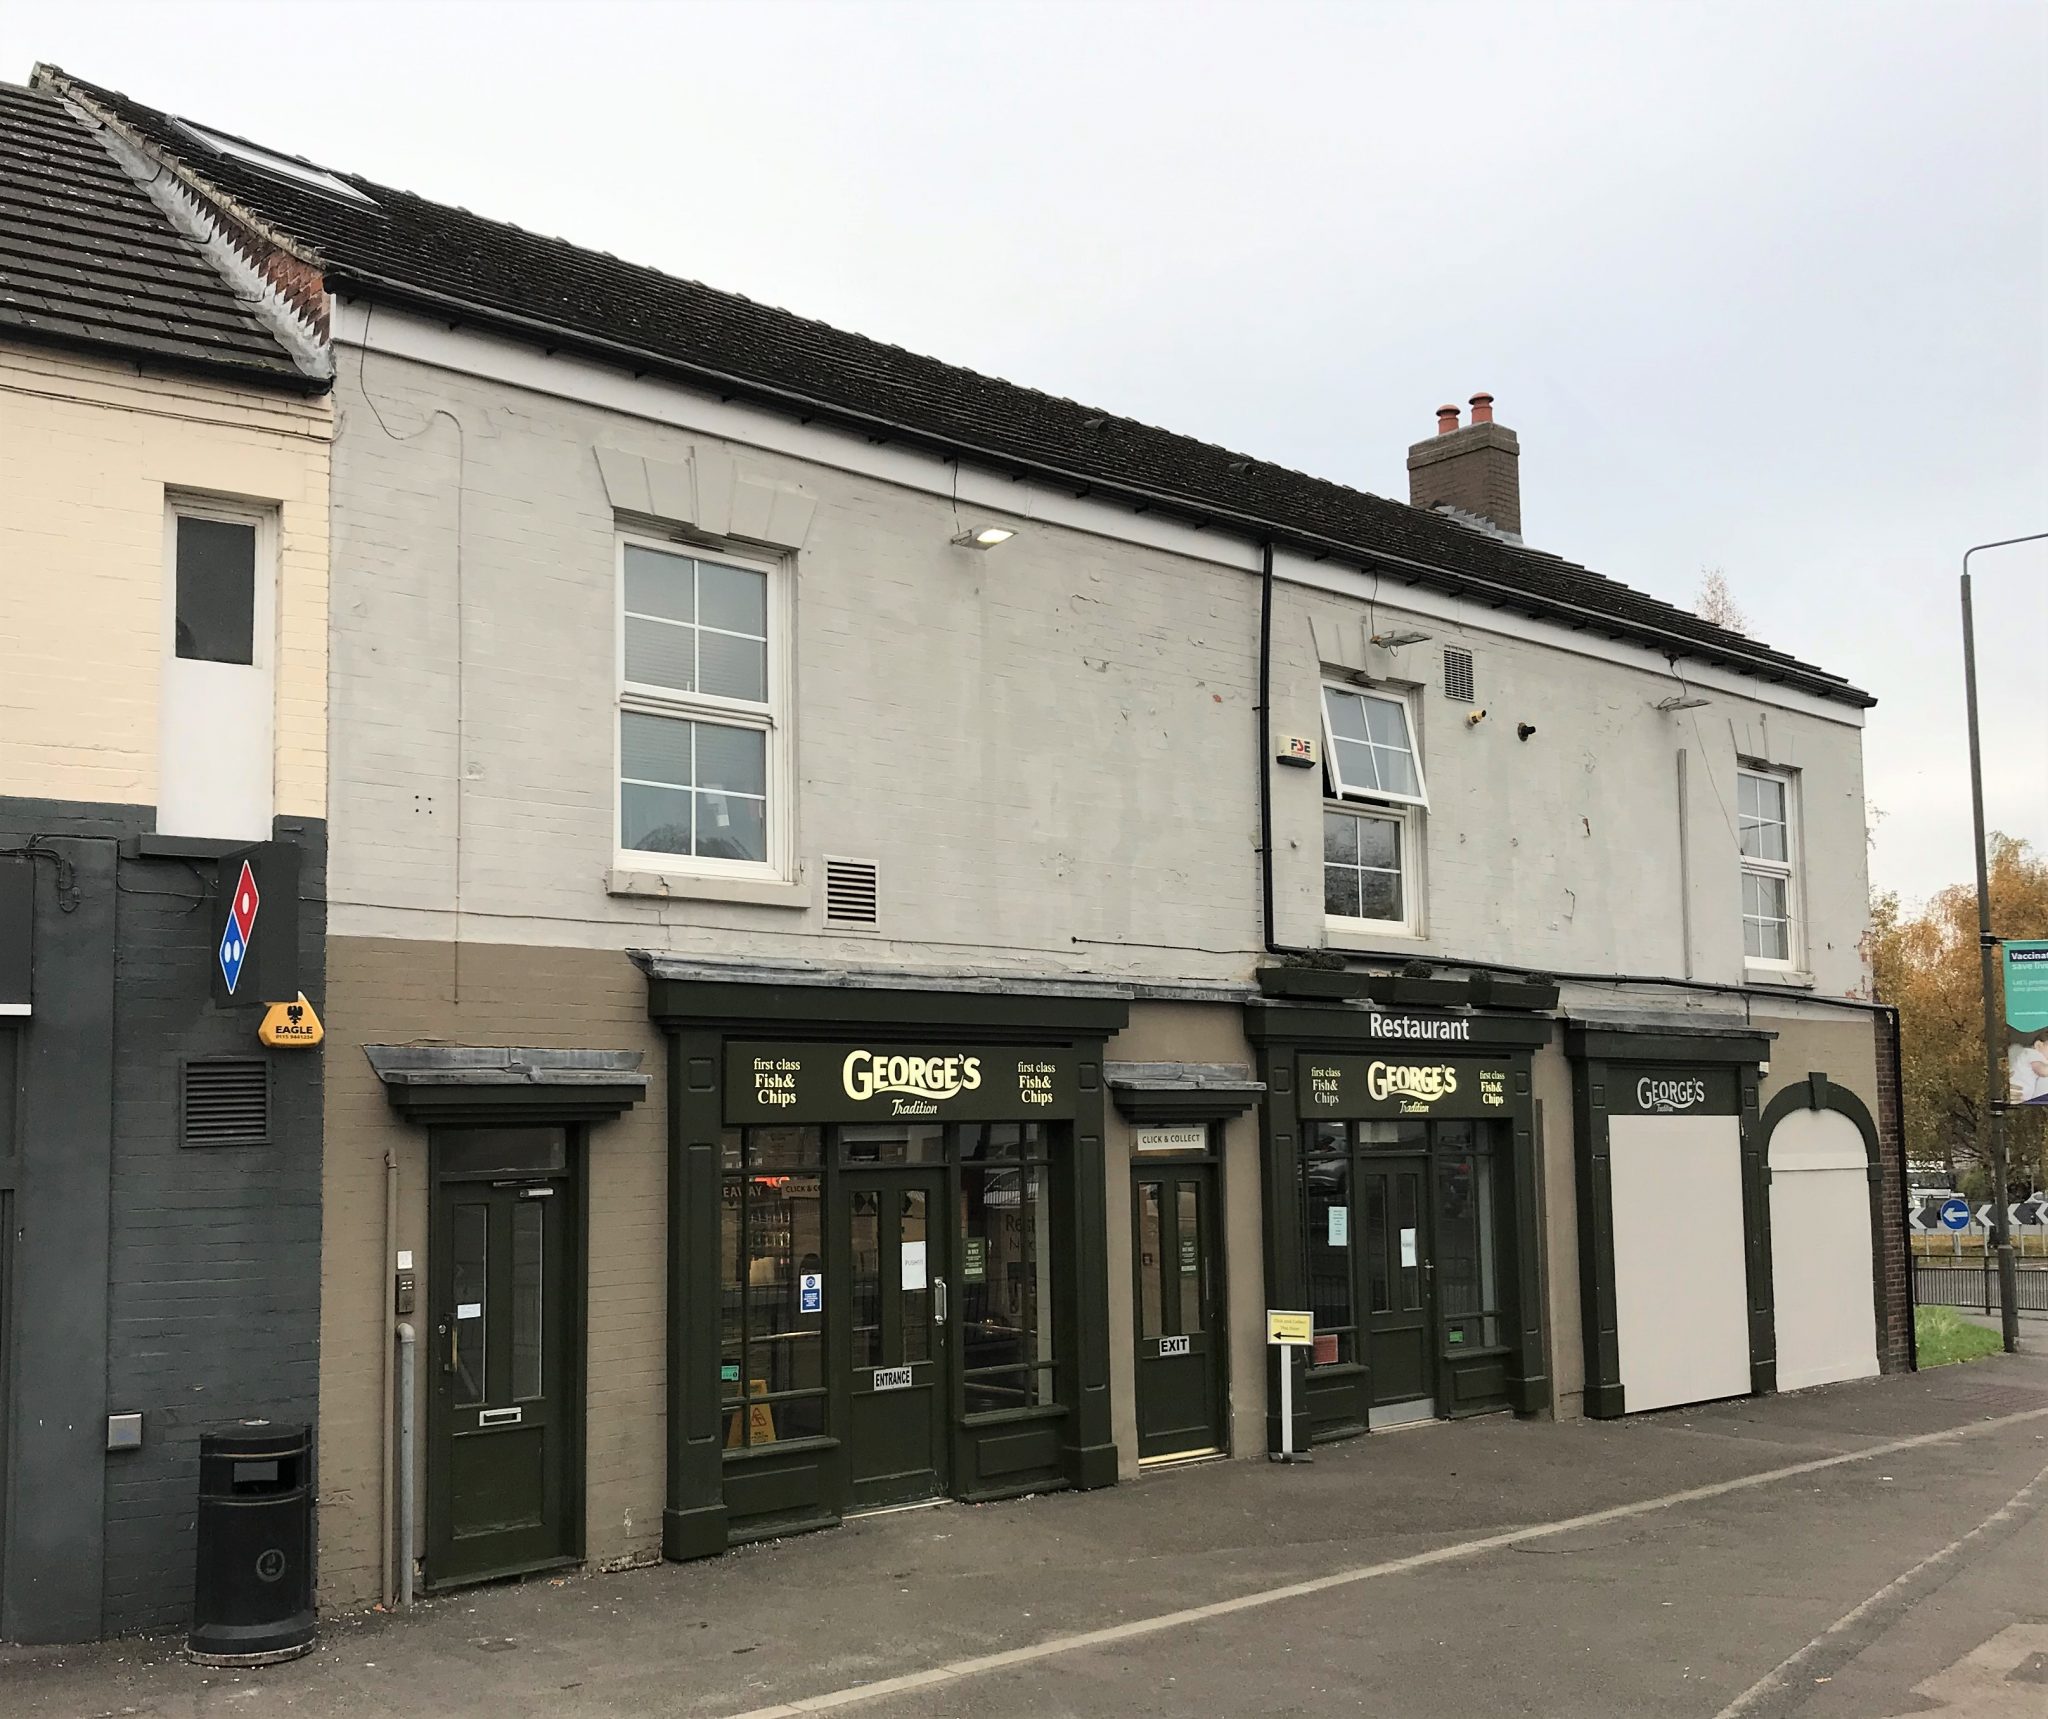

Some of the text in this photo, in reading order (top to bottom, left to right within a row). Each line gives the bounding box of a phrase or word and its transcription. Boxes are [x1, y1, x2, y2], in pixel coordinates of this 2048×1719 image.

[275, 1025, 313, 1035] EAGLE
[1370, 1012, 1470, 1040] Restaurant
[753, 1058, 801, 1071] first class
[1017, 1061, 1056, 1073] first class
[1311, 1066, 1341, 1077] first class
[754, 1073, 796, 1089] Fish&
[842, 1050, 981, 1101] GEORGE'S
[1018, 1075, 1052, 1090] Fish&
[1367, 1060, 1457, 1101] GEORGE'S
[1479, 1070, 1505, 1080] first class
[1312, 1079, 1339, 1091] Fish&
[1480, 1081, 1503, 1093] Fish&
[1637, 1076, 1705, 1109] GEORGE'S
[757, 1088, 797, 1108] Chips
[1021, 1089, 1053, 1106] Chips
[1314, 1091, 1340, 1106] Chips
[1482, 1093, 1504, 1107] Chips
[891, 1098, 938, 1116] Tradition
[1399, 1099, 1429, 1114] Tradition
[1142, 1134, 1200, 1144] CLICK & COLLECT
[785, 1185, 805, 1193] CLICK
[1160, 1338, 1188, 1353] EXIT
[875, 1370, 910, 1387] ENTRANCE
